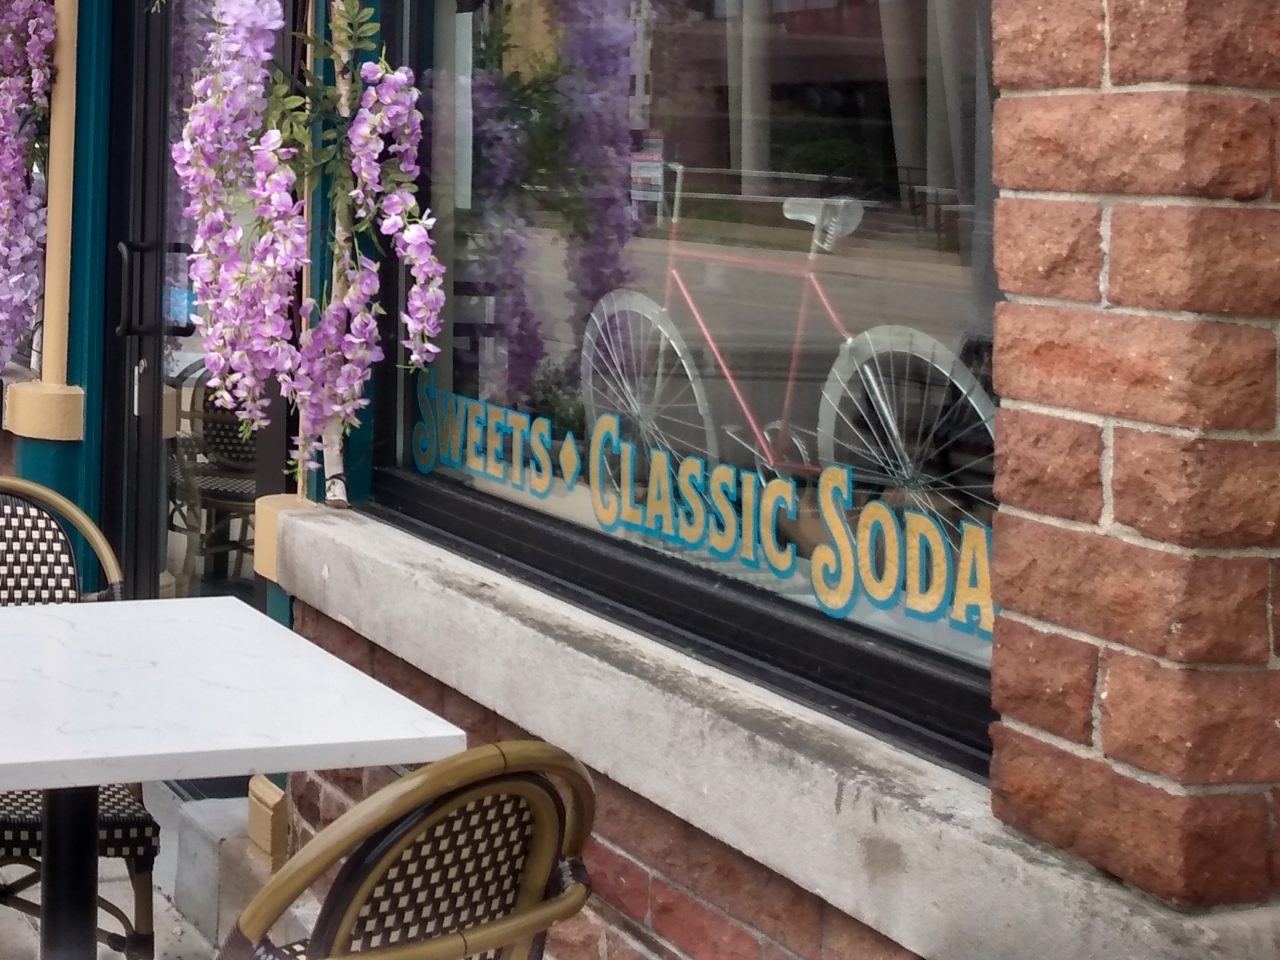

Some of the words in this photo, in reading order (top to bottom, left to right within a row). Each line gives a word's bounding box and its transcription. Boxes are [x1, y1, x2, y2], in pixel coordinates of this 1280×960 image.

[412, 366, 556, 500] SWEETS
[589, 412, 799, 580] CLASSIC
[809, 464, 995, 641] SODA
